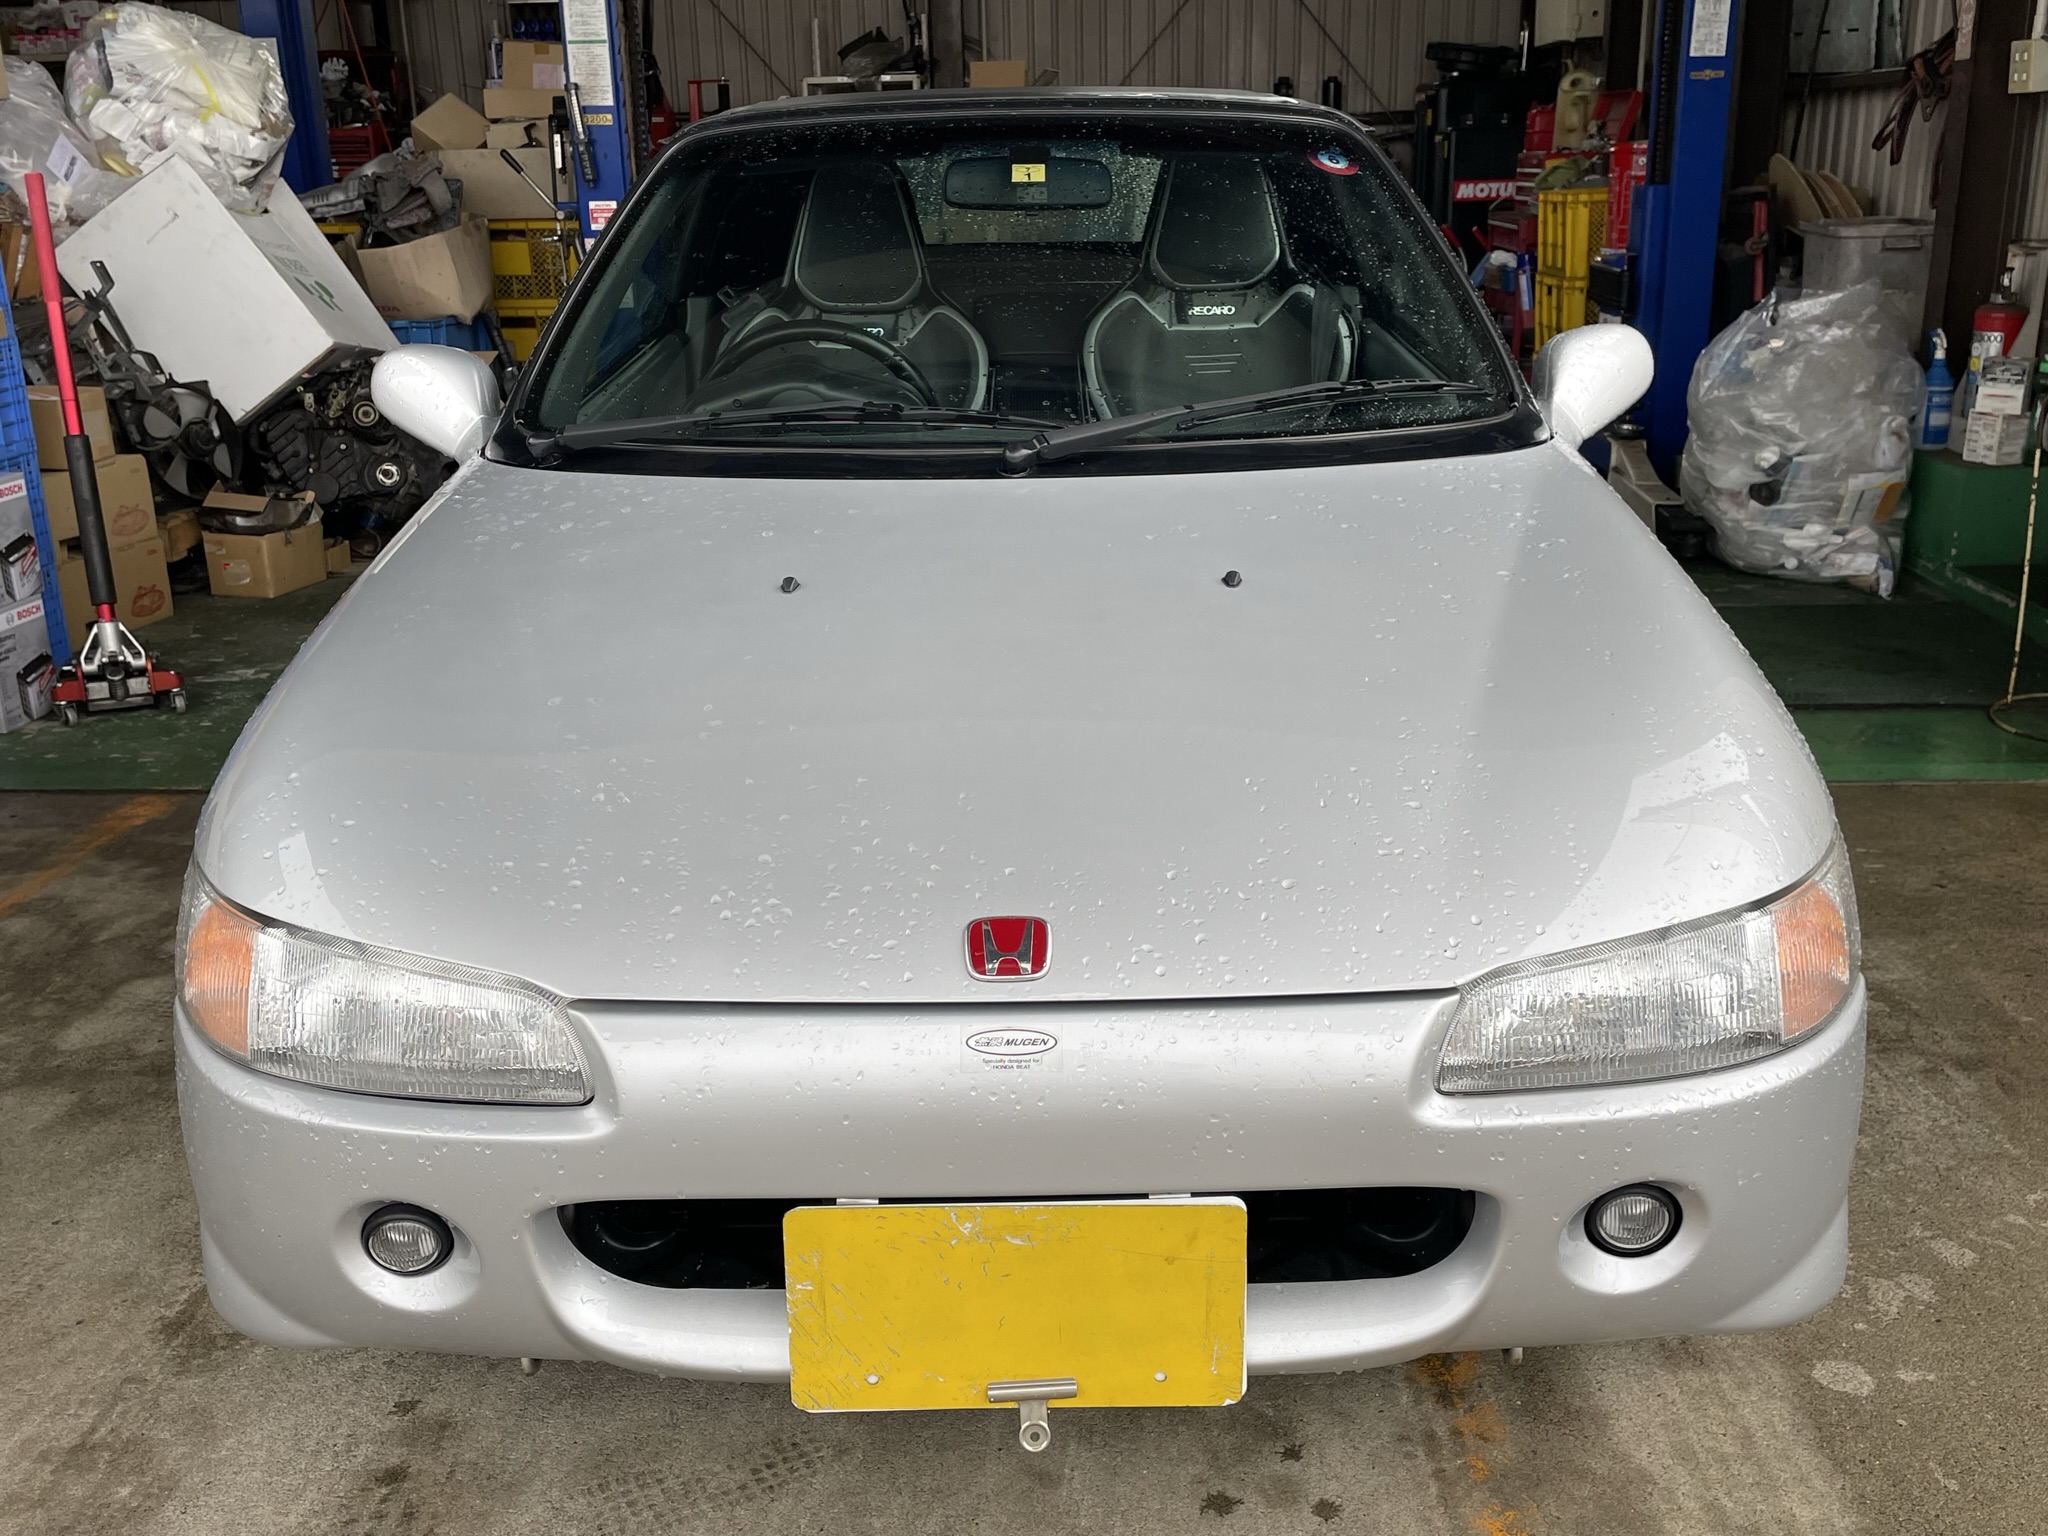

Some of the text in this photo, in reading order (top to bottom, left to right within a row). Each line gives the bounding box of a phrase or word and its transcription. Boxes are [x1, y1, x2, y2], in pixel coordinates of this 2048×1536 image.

[1188, 305, 1236, 316] RECARO
[16, 603, 41, 621] BOSCH
[1003, 1038, 1050, 1047] MUGEN
